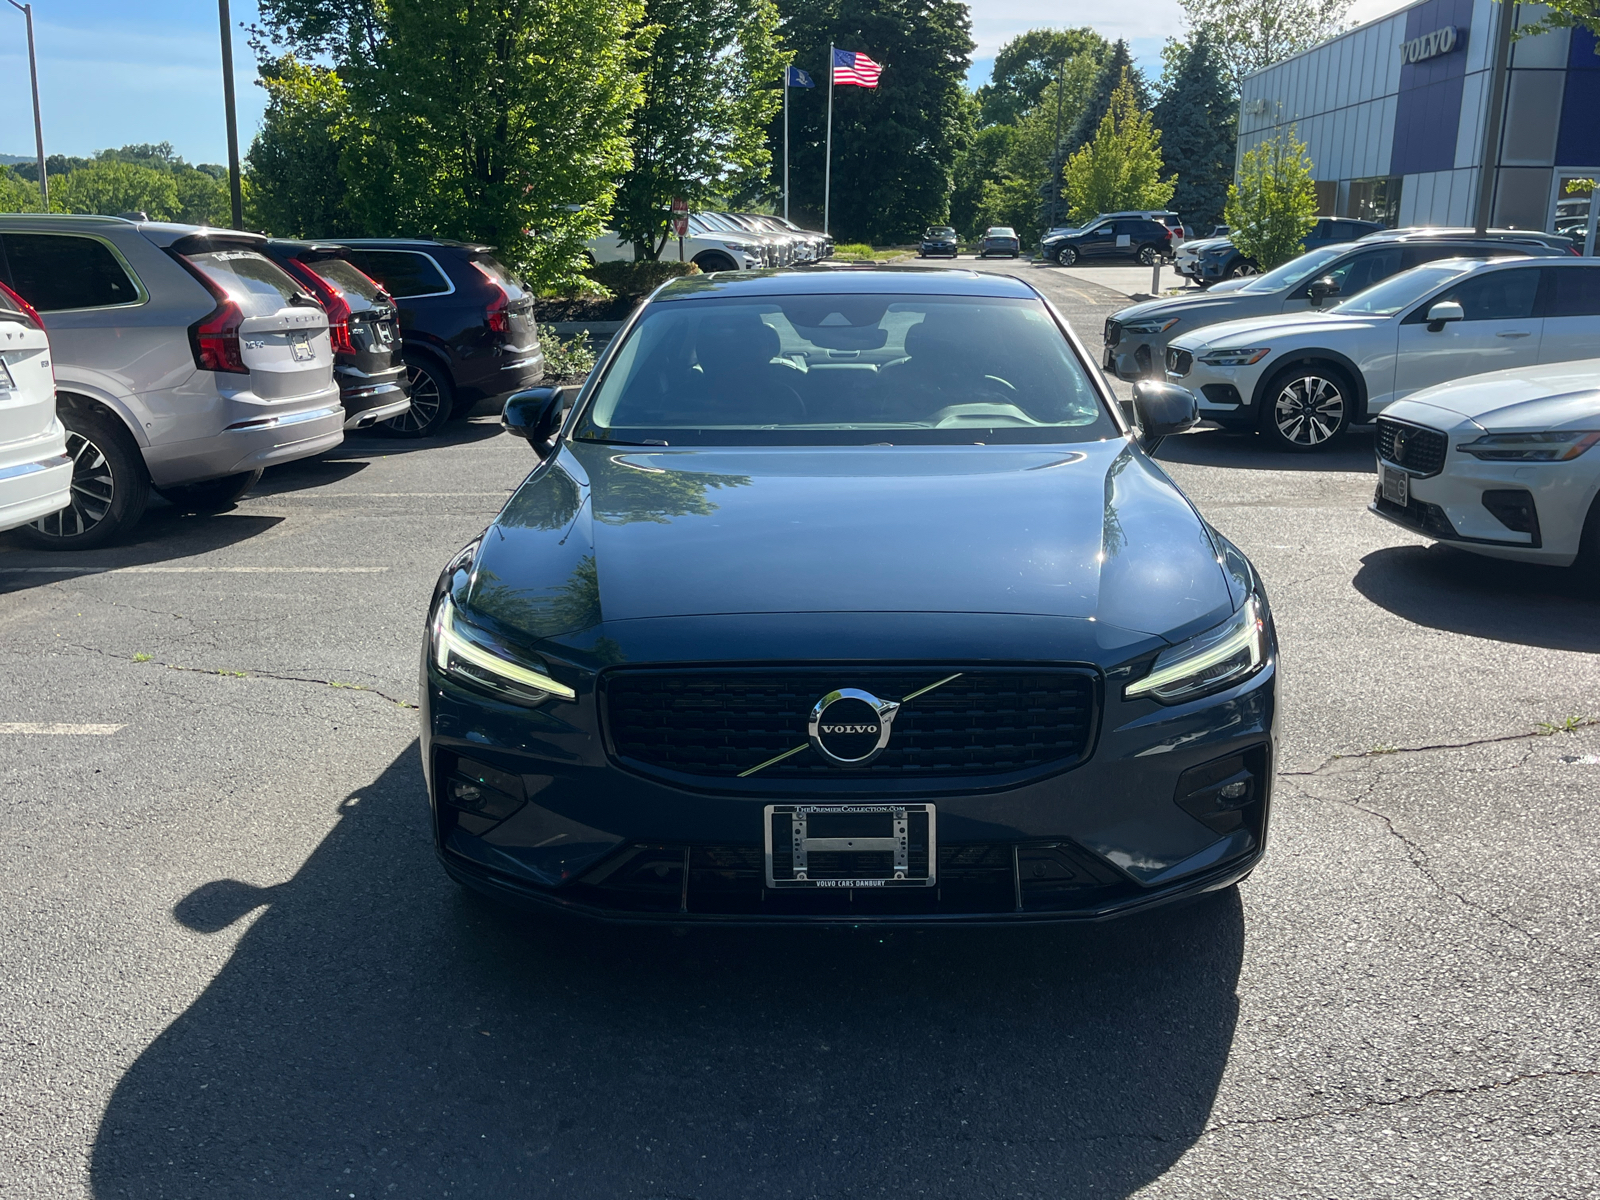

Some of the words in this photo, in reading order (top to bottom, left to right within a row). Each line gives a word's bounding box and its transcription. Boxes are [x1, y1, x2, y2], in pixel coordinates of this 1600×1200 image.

[1399, 26, 1456, 65] VOLVO
[821, 725, 878, 734] VOLVO
[816, 880, 836, 888] VOLVO
[837, 880, 854, 888] CARS
[855, 880, 886, 888] DANBURY
